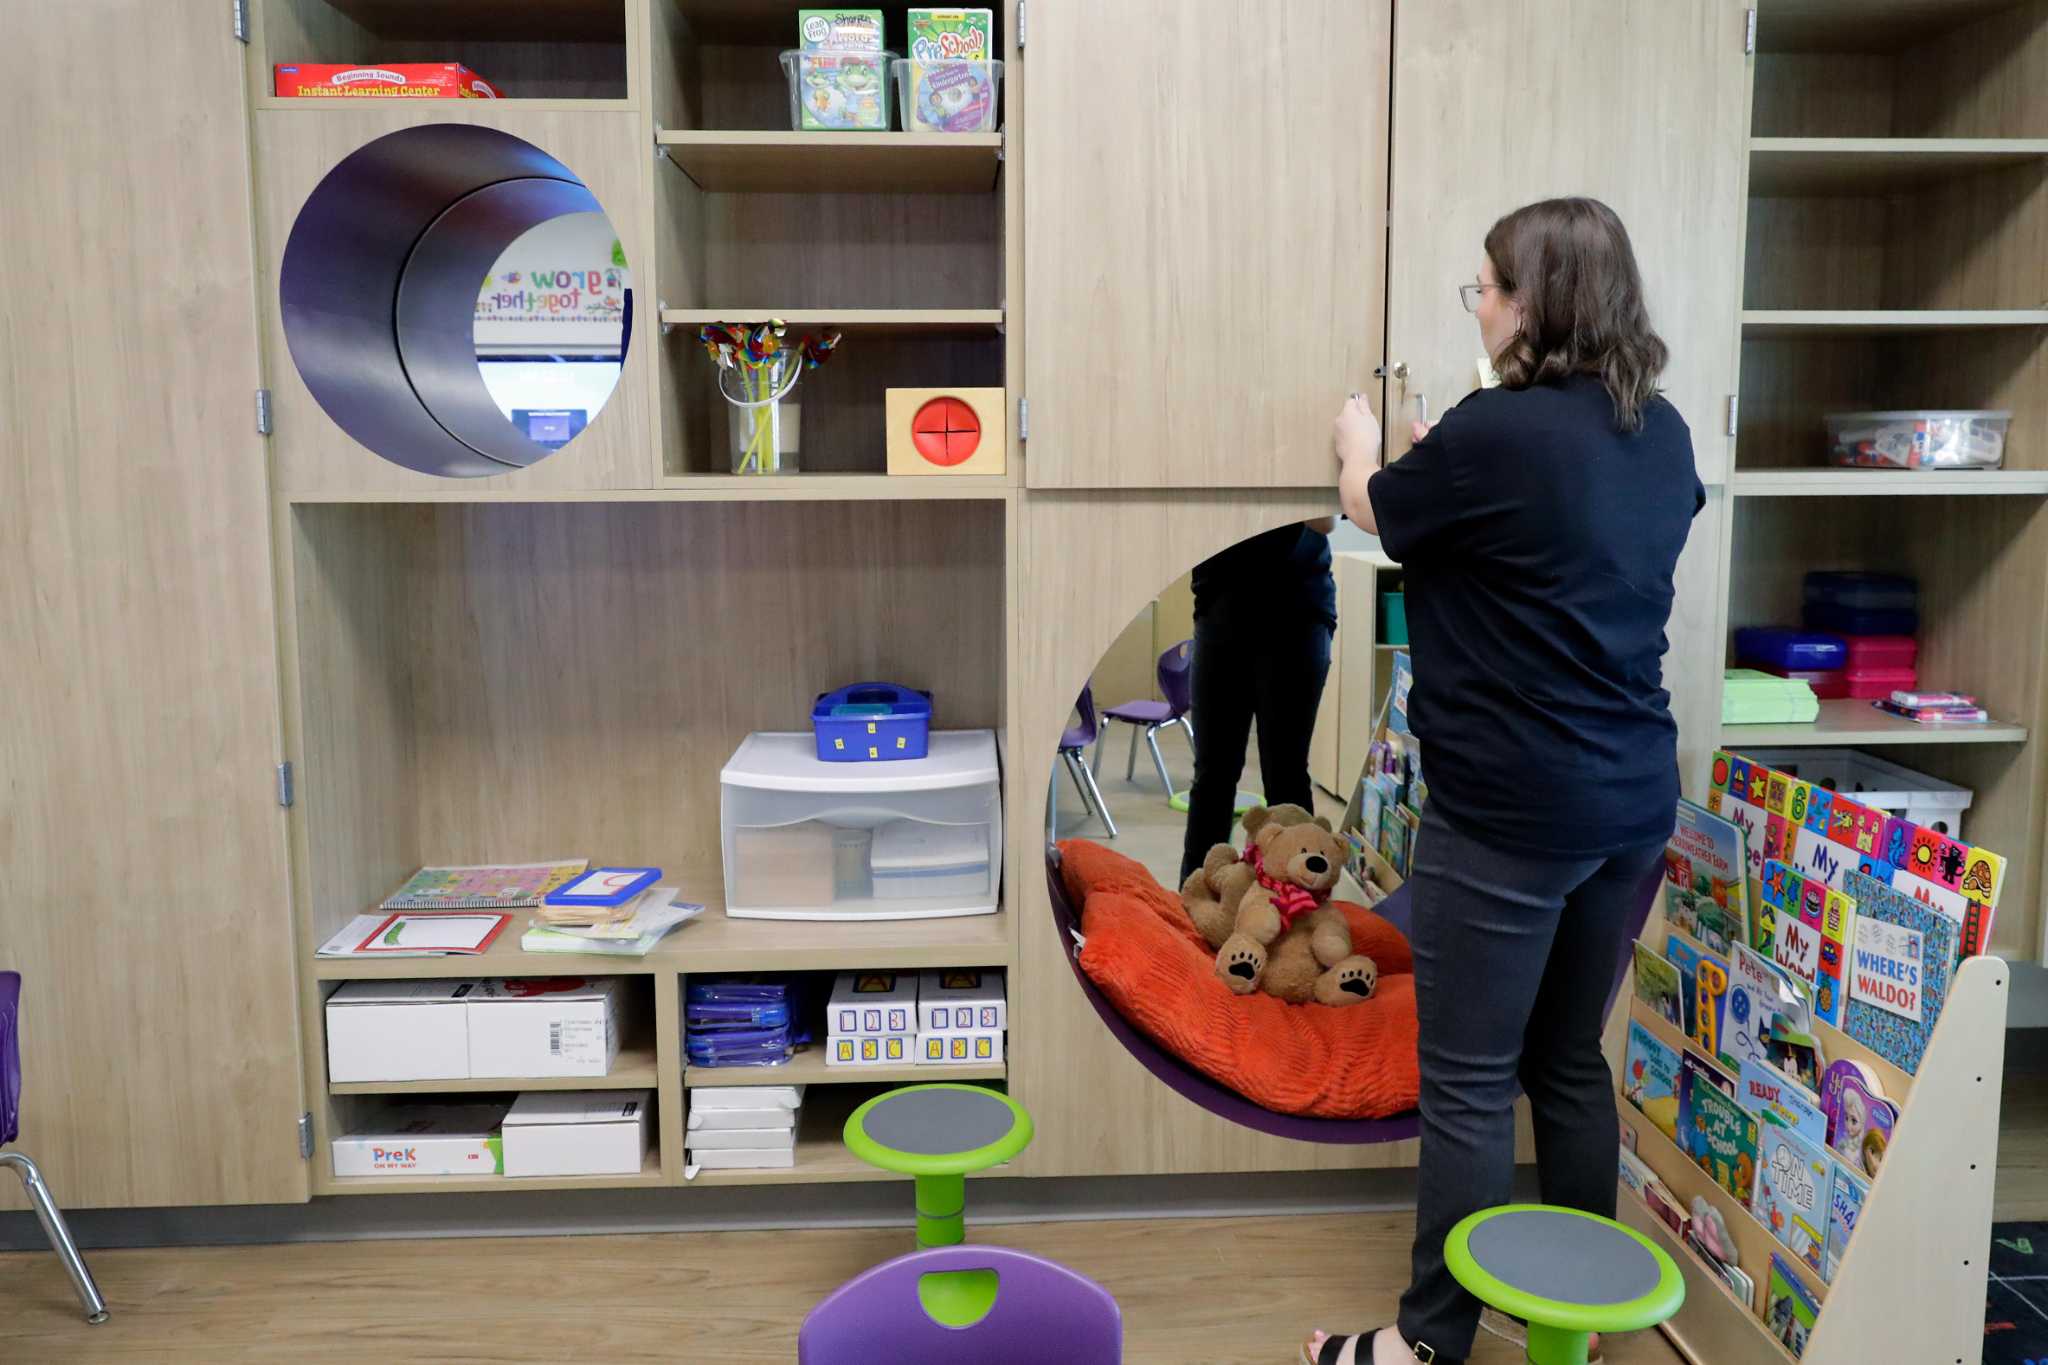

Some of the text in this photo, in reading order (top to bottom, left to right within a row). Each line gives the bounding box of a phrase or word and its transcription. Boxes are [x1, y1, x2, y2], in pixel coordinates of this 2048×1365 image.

[806, 20, 825, 30] Leap
[808, 28, 827, 38] Frog
[297, 85, 441, 97] Instant Learning Center
[336, 71, 404, 82] Beginning Sounds
[1732, 807, 1754, 836] My
[1812, 843, 1839, 881] My
[1785, 922, 1809, 963] My
[1739, 950, 1763, 983] Pete
[1857, 949, 1918, 989] WHERE'S
[1857, 975, 1916, 1011] WALDO?
[840, 1042, 851, 1058] A
[929, 1040, 940, 1057] A
[1748, 1079, 1780, 1103] READY
[1701, 1098, 1742, 1137] TROUBLE
[1713, 1119, 1727, 1138] AT
[372, 1147, 417, 1162] PreK
[1706, 1126, 1739, 1156] SCHOOL
[1775, 1143, 1806, 1183] ON
[1771, 1159, 1814, 1211] TIME
[1833, 1194, 1856, 1231] SHA
